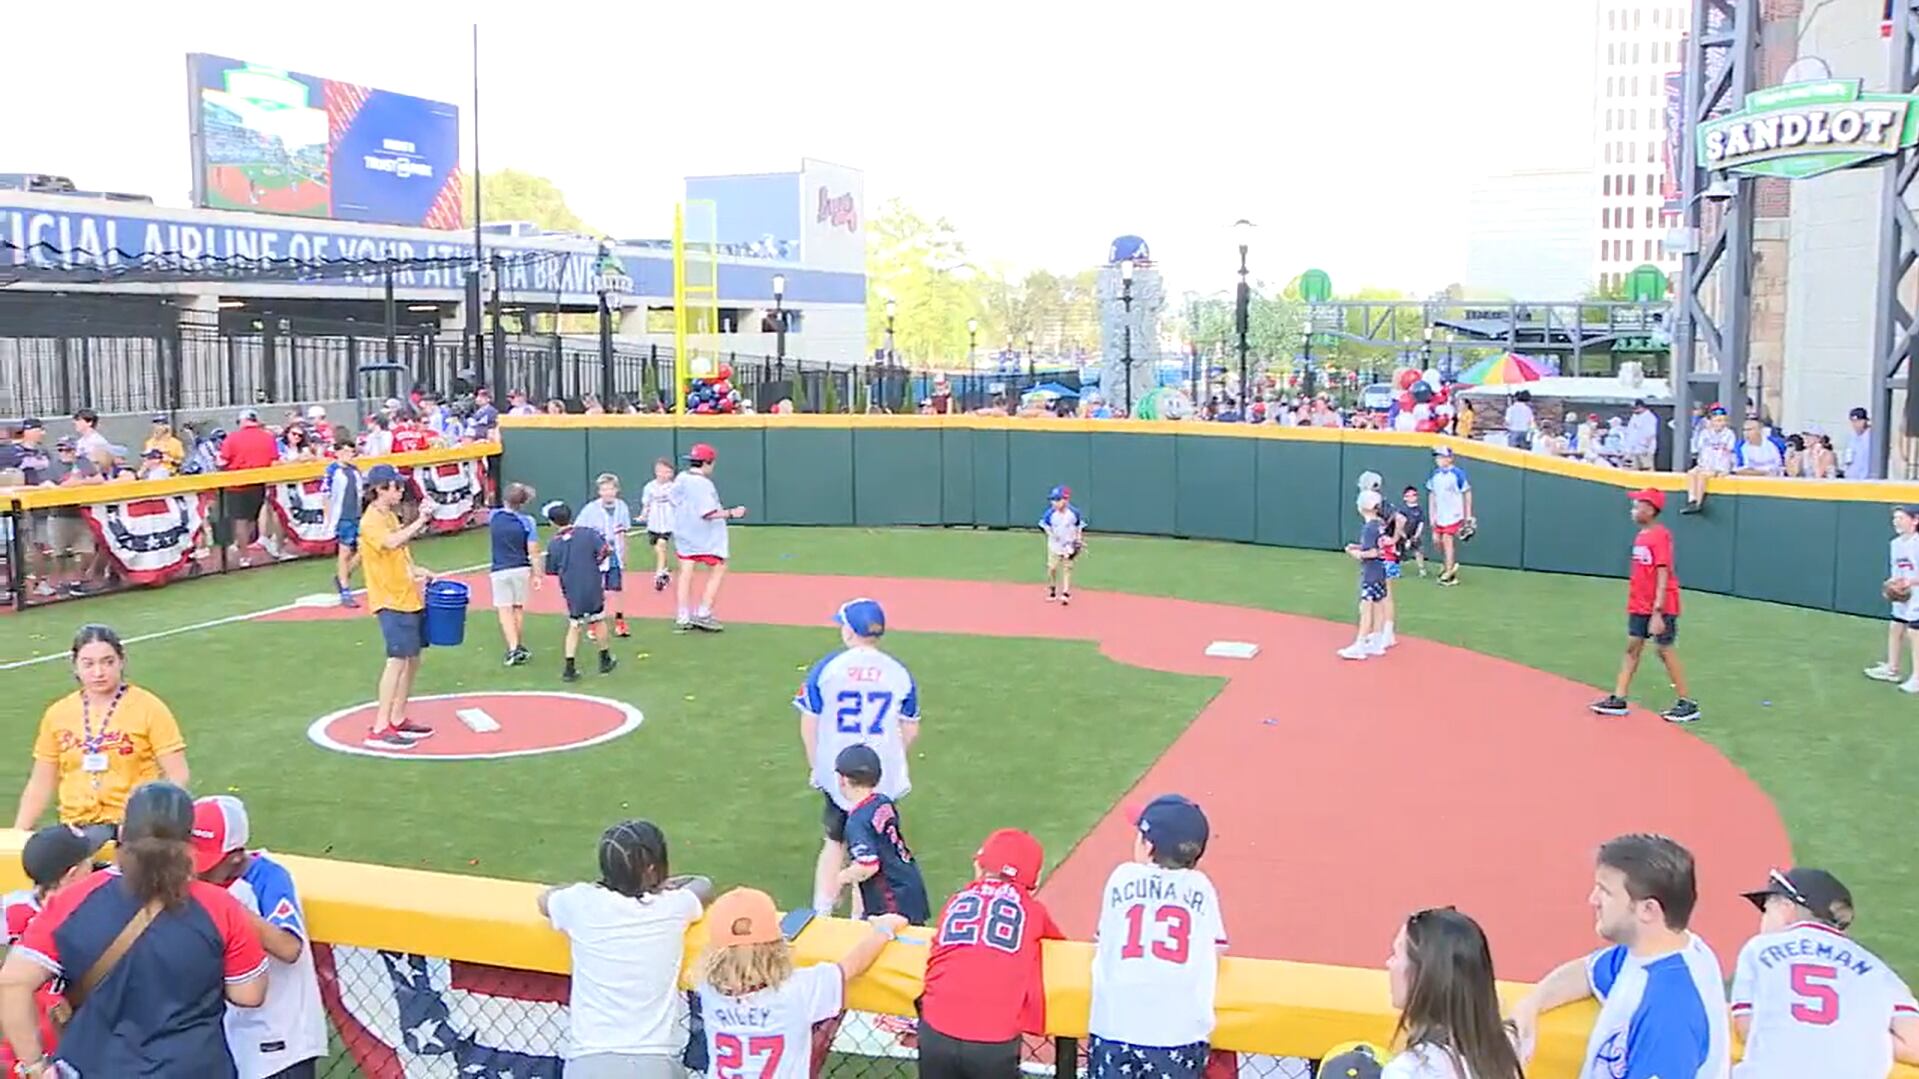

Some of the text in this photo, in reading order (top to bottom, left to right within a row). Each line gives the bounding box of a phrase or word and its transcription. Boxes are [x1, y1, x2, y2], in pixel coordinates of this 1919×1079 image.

[1705, 109, 1893, 161] SANDLOT
[143, 222, 278, 275] AIRLINE
[291, 233, 329, 280] OF
[338, 237, 415, 284] YOUR
[424, 245, 528, 289] ATLTA
[536, 250, 599, 292] BRAVE
[837, 691, 893, 734] 27
[1111, 873, 1178, 908] ACUÑA
[940, 892, 1025, 953] 28
[1121, 903, 1192, 965] 13
[1759, 938, 1873, 976] FREEMAN
[715, 1007, 771, 1028] RILEY
[1790, 963, 1840, 1025] 5
[714, 1031, 785, 1079] 27
